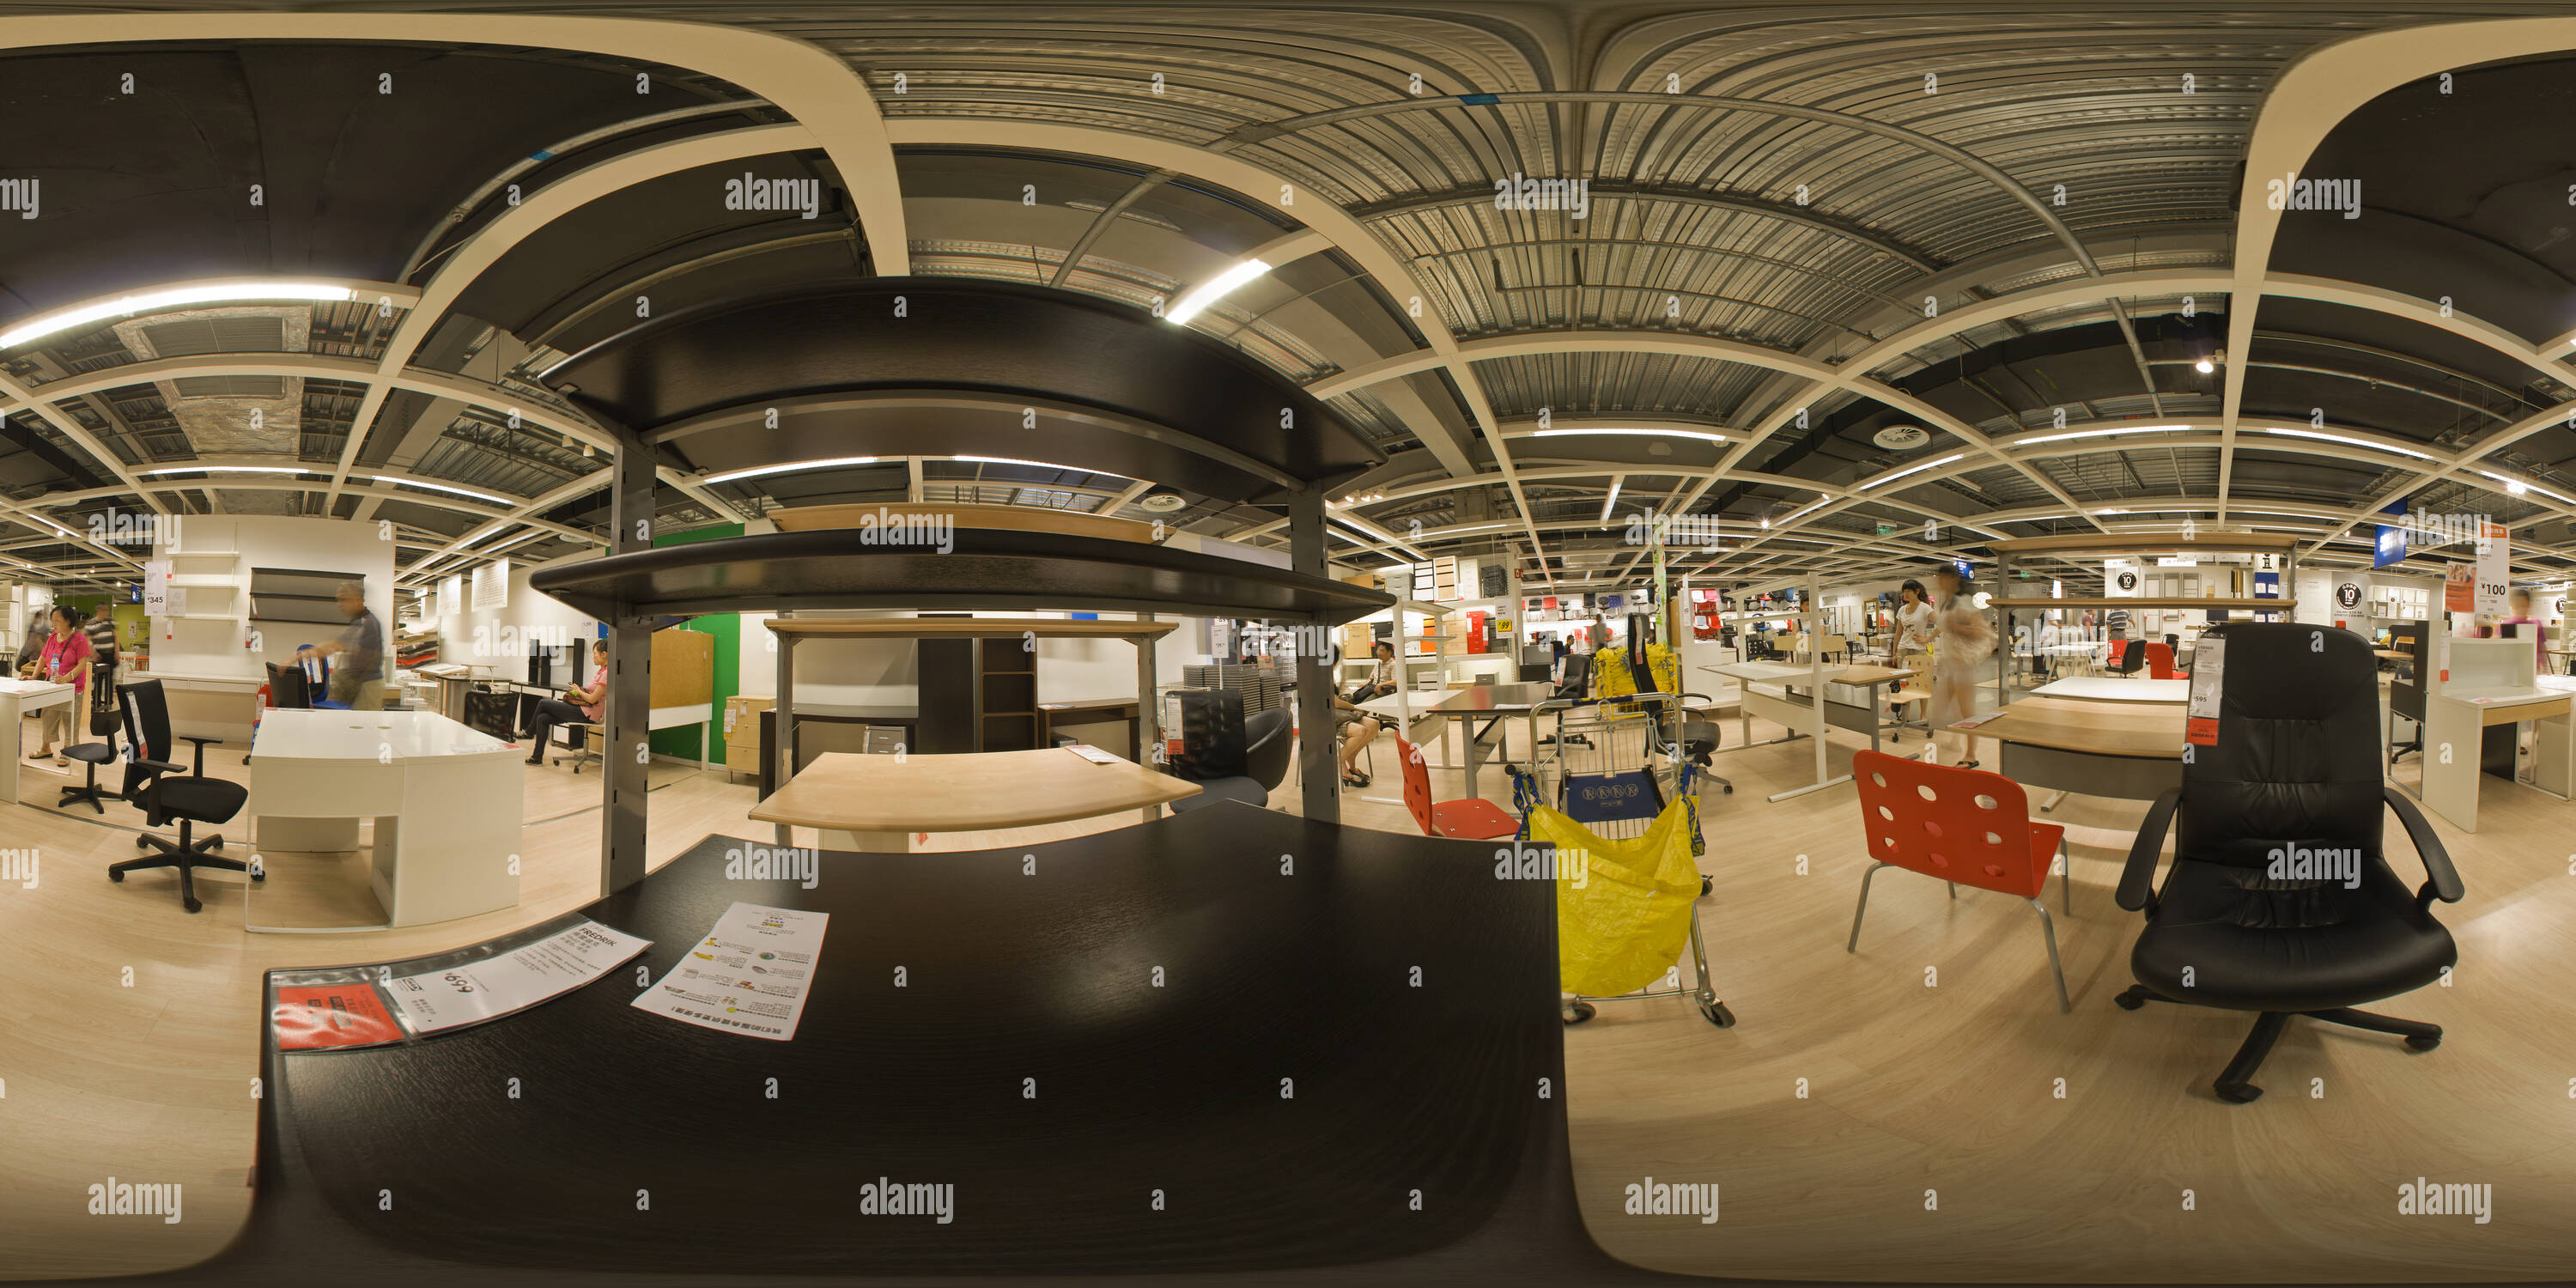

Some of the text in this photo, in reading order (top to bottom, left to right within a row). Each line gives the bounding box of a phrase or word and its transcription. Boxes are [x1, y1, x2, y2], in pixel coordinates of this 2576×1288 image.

[2343, 589, 2355, 600] 10
[2481, 582, 2506, 596] ¥100
[580, 927, 617, 946] FREDRIK
